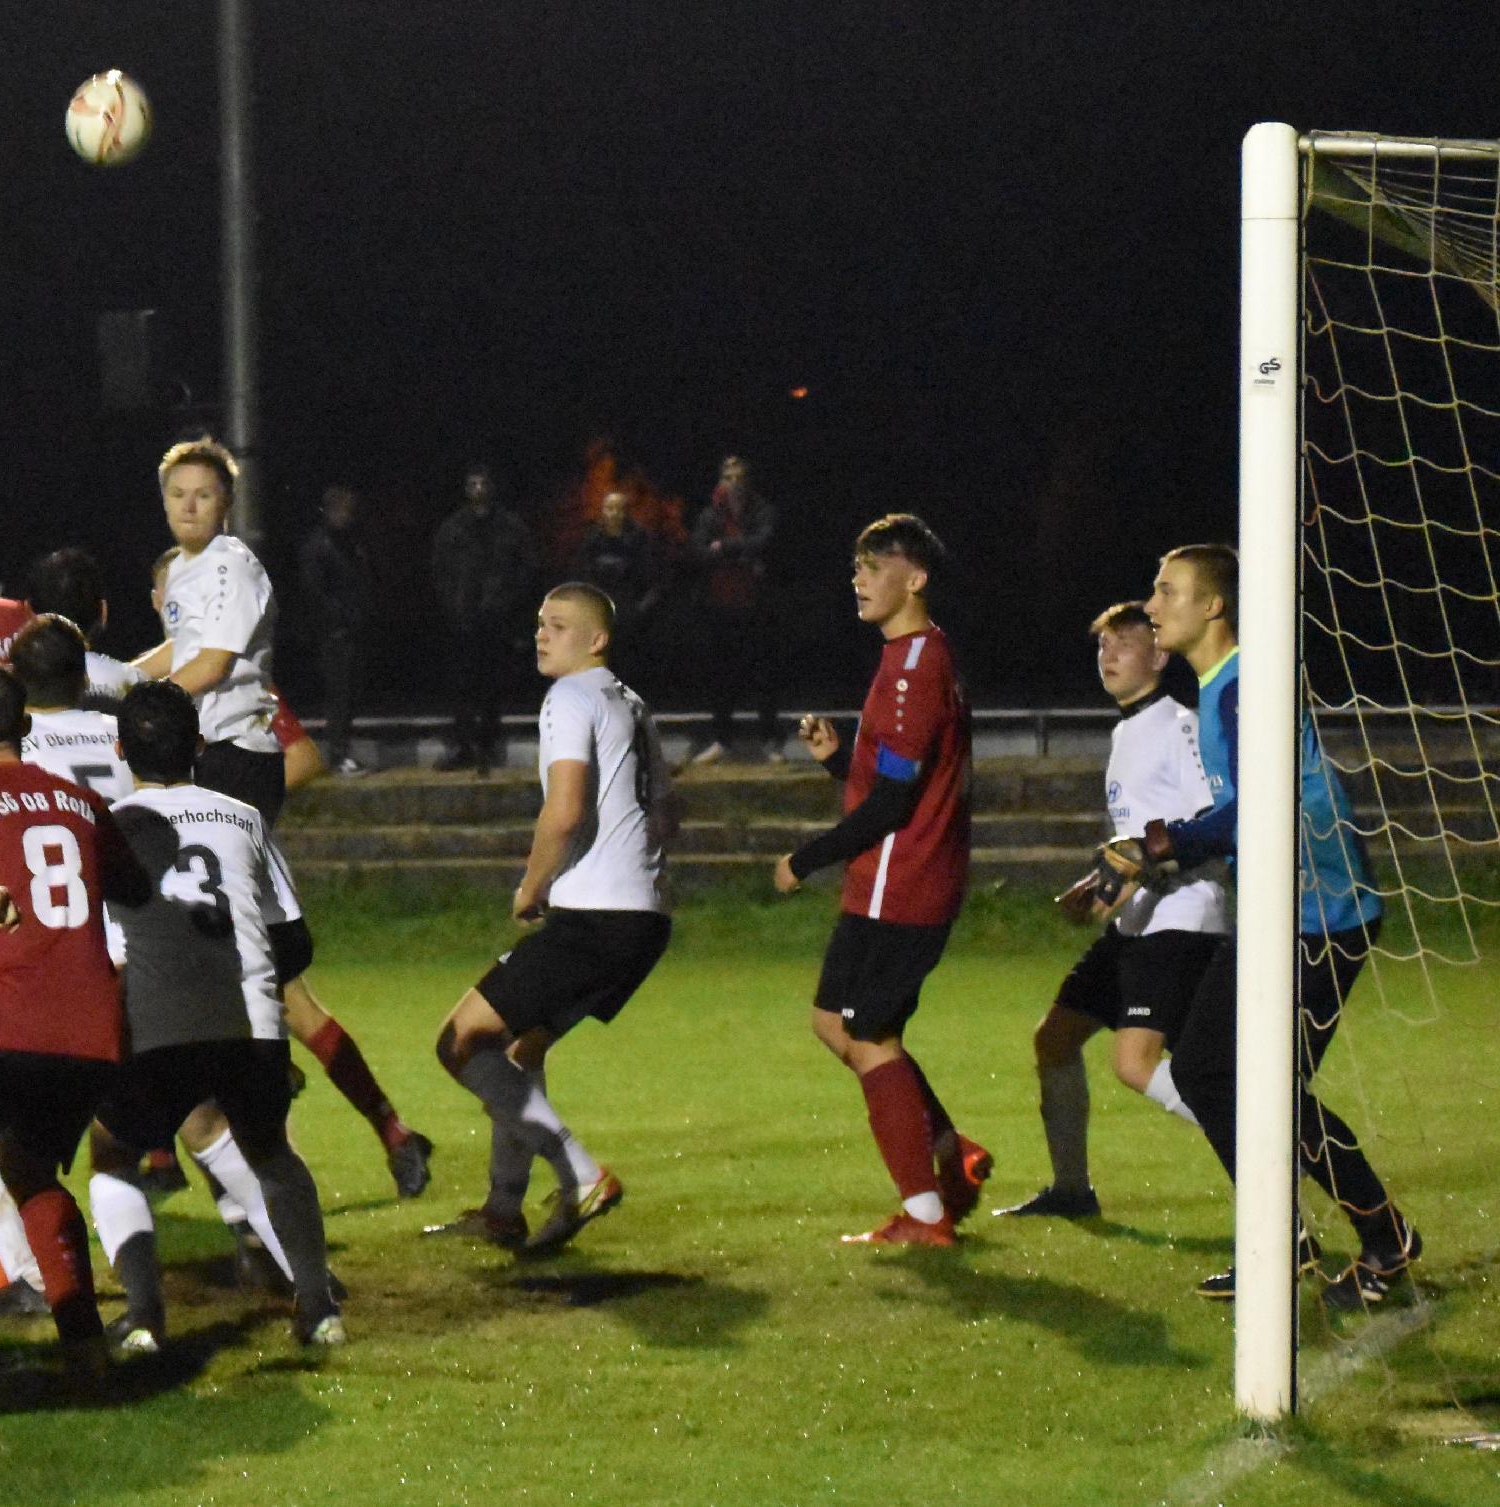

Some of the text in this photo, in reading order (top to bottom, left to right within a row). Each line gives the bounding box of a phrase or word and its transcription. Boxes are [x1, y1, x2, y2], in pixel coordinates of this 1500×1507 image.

[20, 732, 119, 754] SV Oberhoch
[20, 791, 50, 813] 08
[164, 809, 254, 833] erhochstatt
[22, 824, 90, 930] 8
